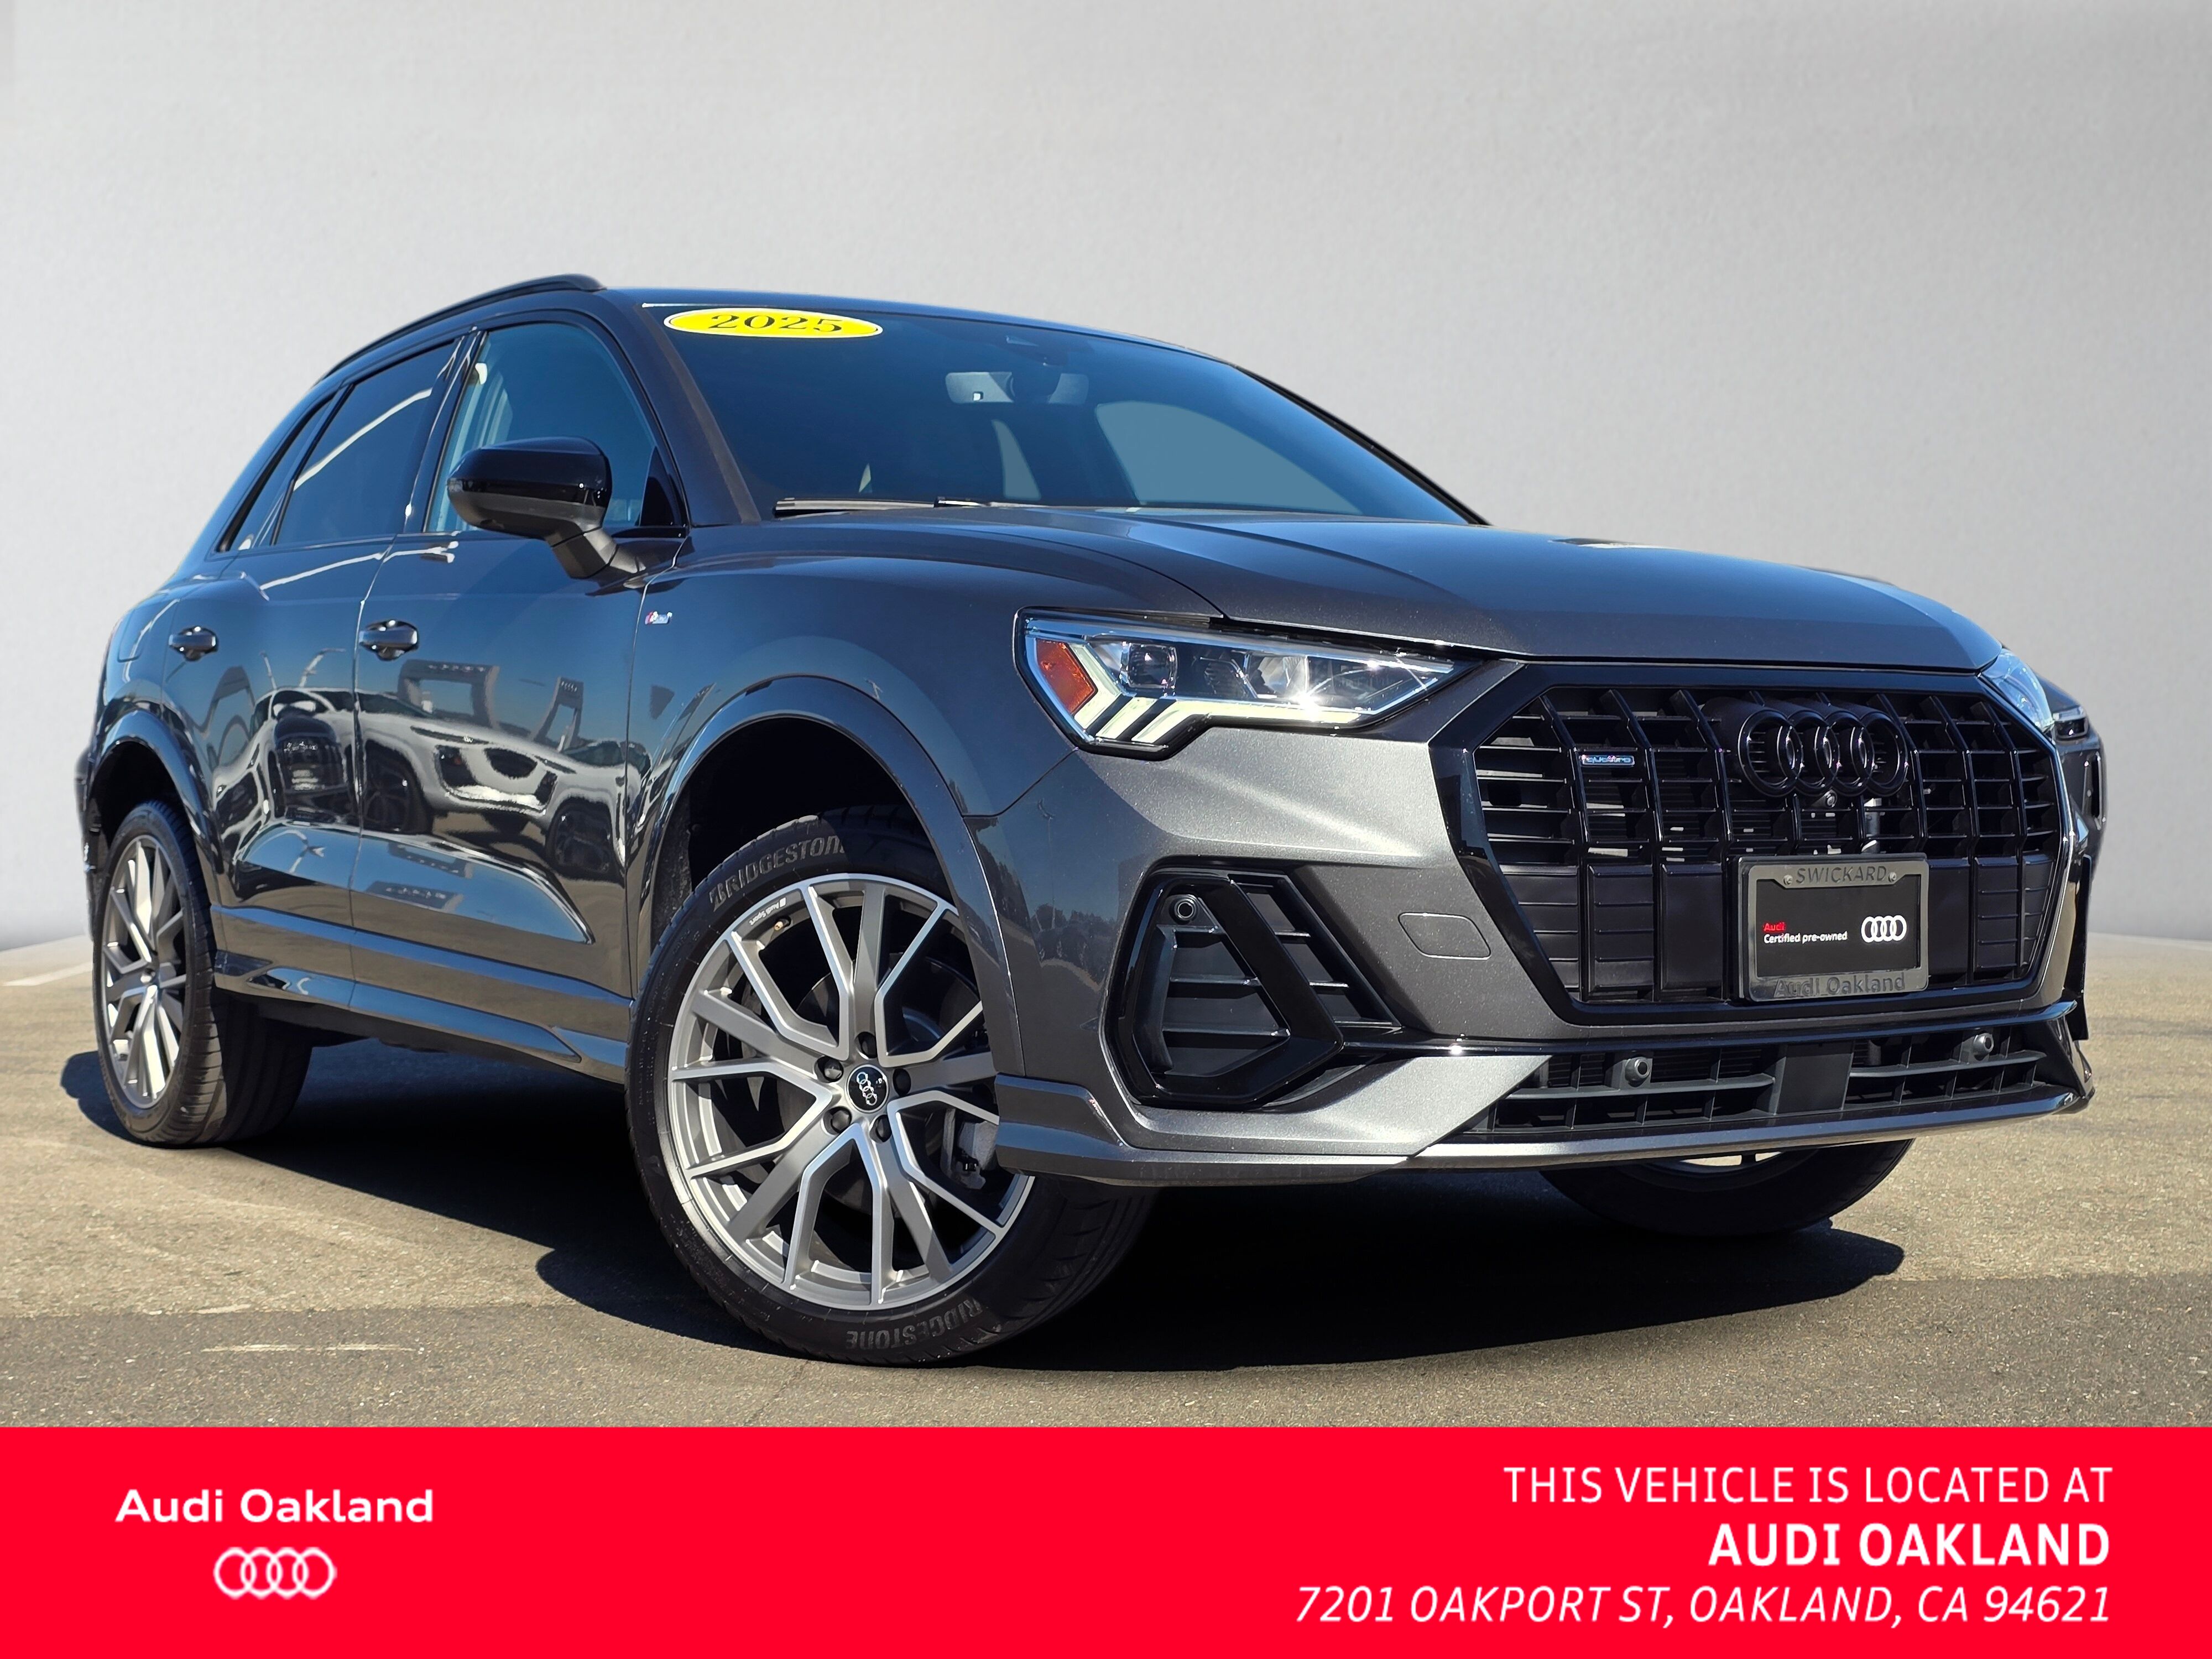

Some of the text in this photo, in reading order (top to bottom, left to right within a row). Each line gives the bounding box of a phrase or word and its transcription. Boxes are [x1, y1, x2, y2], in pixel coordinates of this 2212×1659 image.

[708, 314, 843, 332] 2025
[708, 834, 845, 912] BRIDGESTON
[1795, 865, 1887, 884] SWICKARD
[1764, 922, 1785, 931] Audi
[1764, 931, 1848, 944] Certified pre-owned
[1773, 972, 1905, 997] Audi Oakland
[846, 1300, 983, 1350] RIDGESTONE
